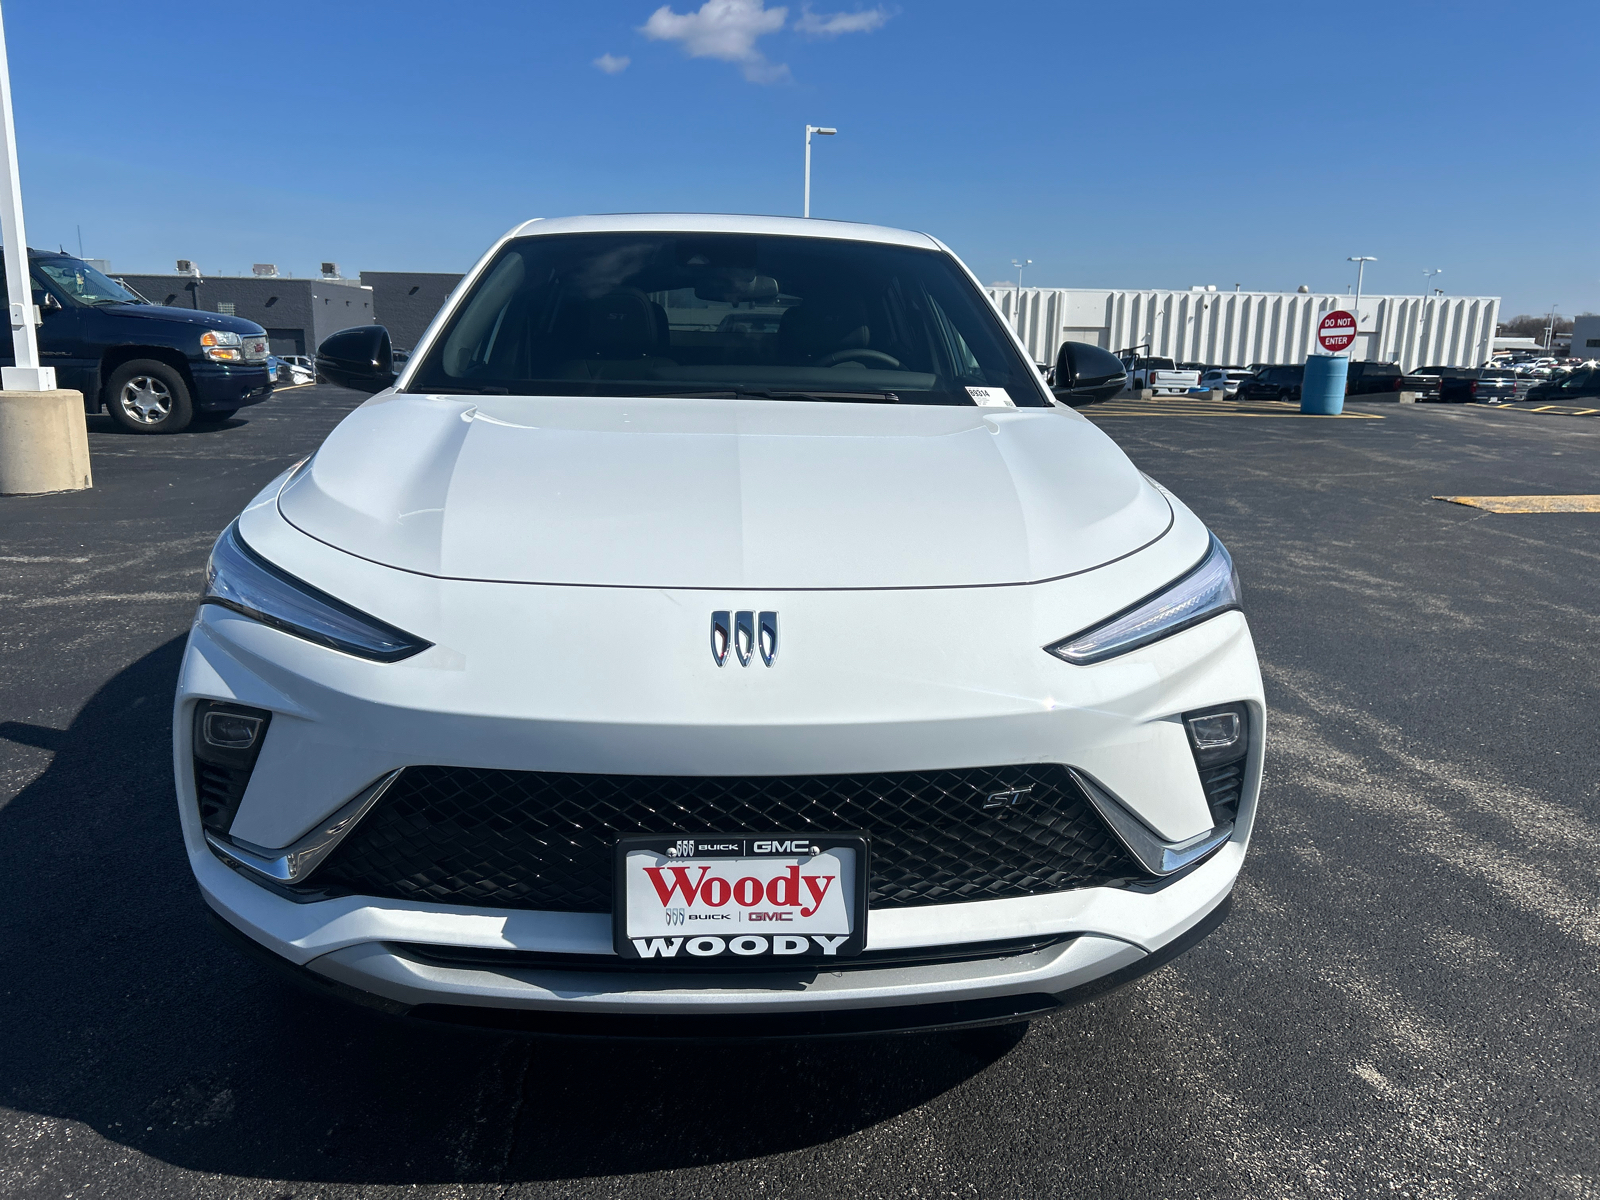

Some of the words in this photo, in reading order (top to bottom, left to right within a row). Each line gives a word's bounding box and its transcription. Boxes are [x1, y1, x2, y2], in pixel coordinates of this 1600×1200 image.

[1325, 319, 1335, 327] DO
[1337, 318, 1352, 326] NOT
[1325, 337, 1347, 345] ENTER
[982, 787, 1032, 809] ST
[753, 840, 810, 853] GMC
[642, 865, 836, 918] Woody
[748, 911, 793, 922] GMC
[632, 935, 850, 959] WOODY
